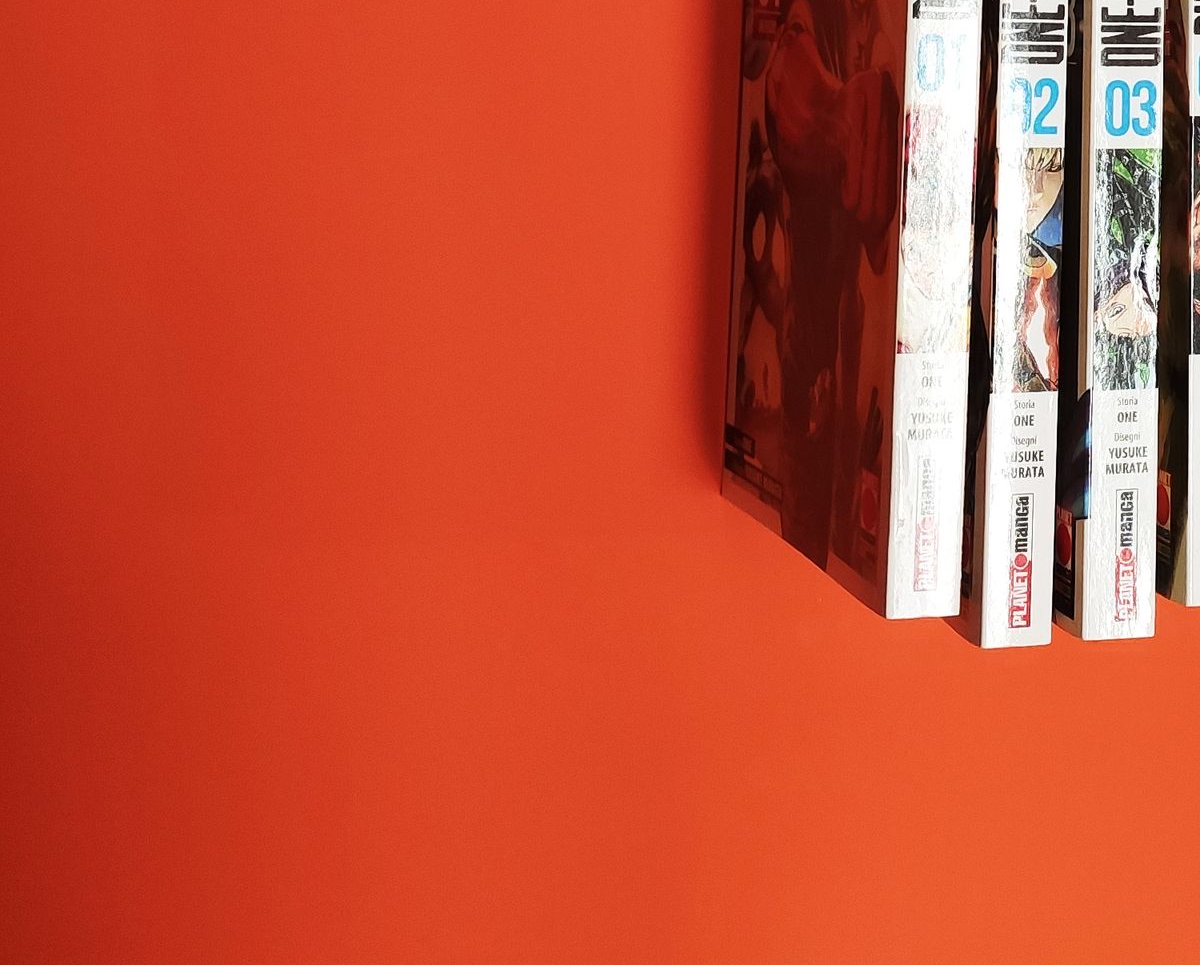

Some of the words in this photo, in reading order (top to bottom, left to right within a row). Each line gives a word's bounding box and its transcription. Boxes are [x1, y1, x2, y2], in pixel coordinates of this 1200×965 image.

[1010, 77, 1059, 134] 02
[1104, 79, 1158, 137] 03
[1014, 399, 1035, 409] Storia
[1117, 397, 1138, 406] Storia
[1014, 415, 1035, 426] ONE
[1117, 411, 1138, 423] ONE
[1114, 432, 1141, 443] Disegni
[1108, 447, 1148, 458] YUSUKE
[1105, 462, 1149, 475] MURATA
[1011, 569, 1028, 627] PLANET
